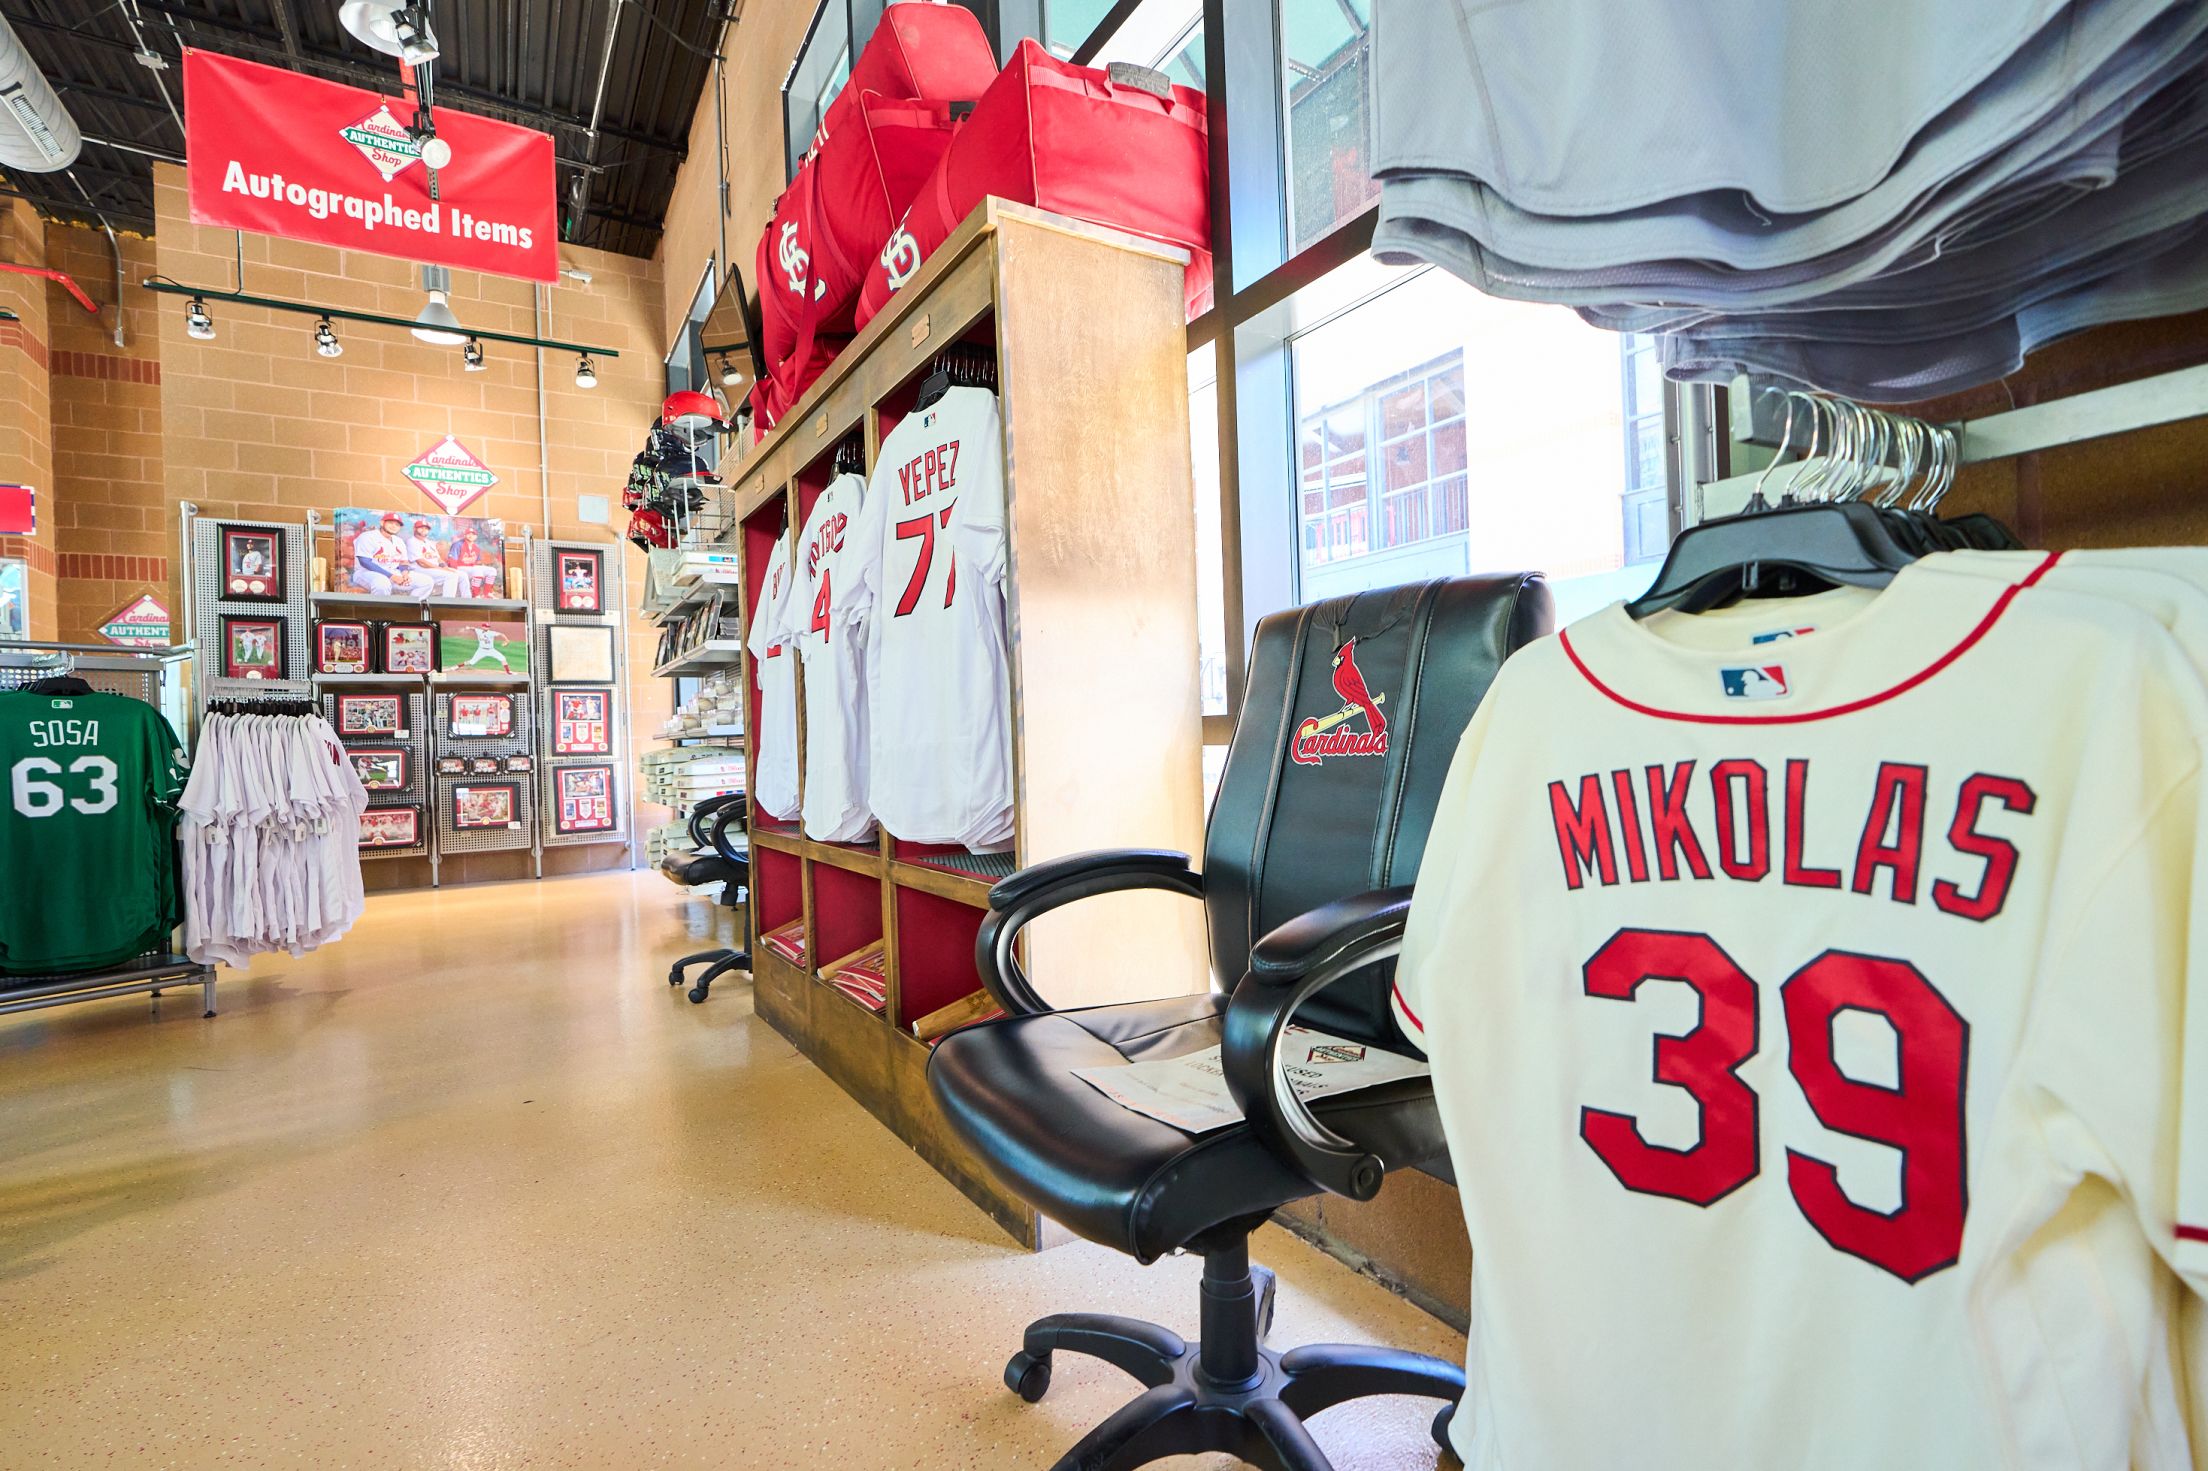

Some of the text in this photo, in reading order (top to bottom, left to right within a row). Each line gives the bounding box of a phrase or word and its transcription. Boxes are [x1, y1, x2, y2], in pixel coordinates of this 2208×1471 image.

[372, 148, 402, 168] Shop
[222, 160, 533, 249] Autographed Items
[412, 467, 489, 483] AUTHENTICS
[436, 481, 468, 498] Shop
[898, 440, 960, 506] YEPEZ
[29, 719, 99, 747] SOSA
[1291, 717, 1388, 766] Cardinals
[11, 755, 118, 818] 63
[1547, 757, 2039, 923] MIKOLAS
[1580, 926, 1971, 1287] 39
